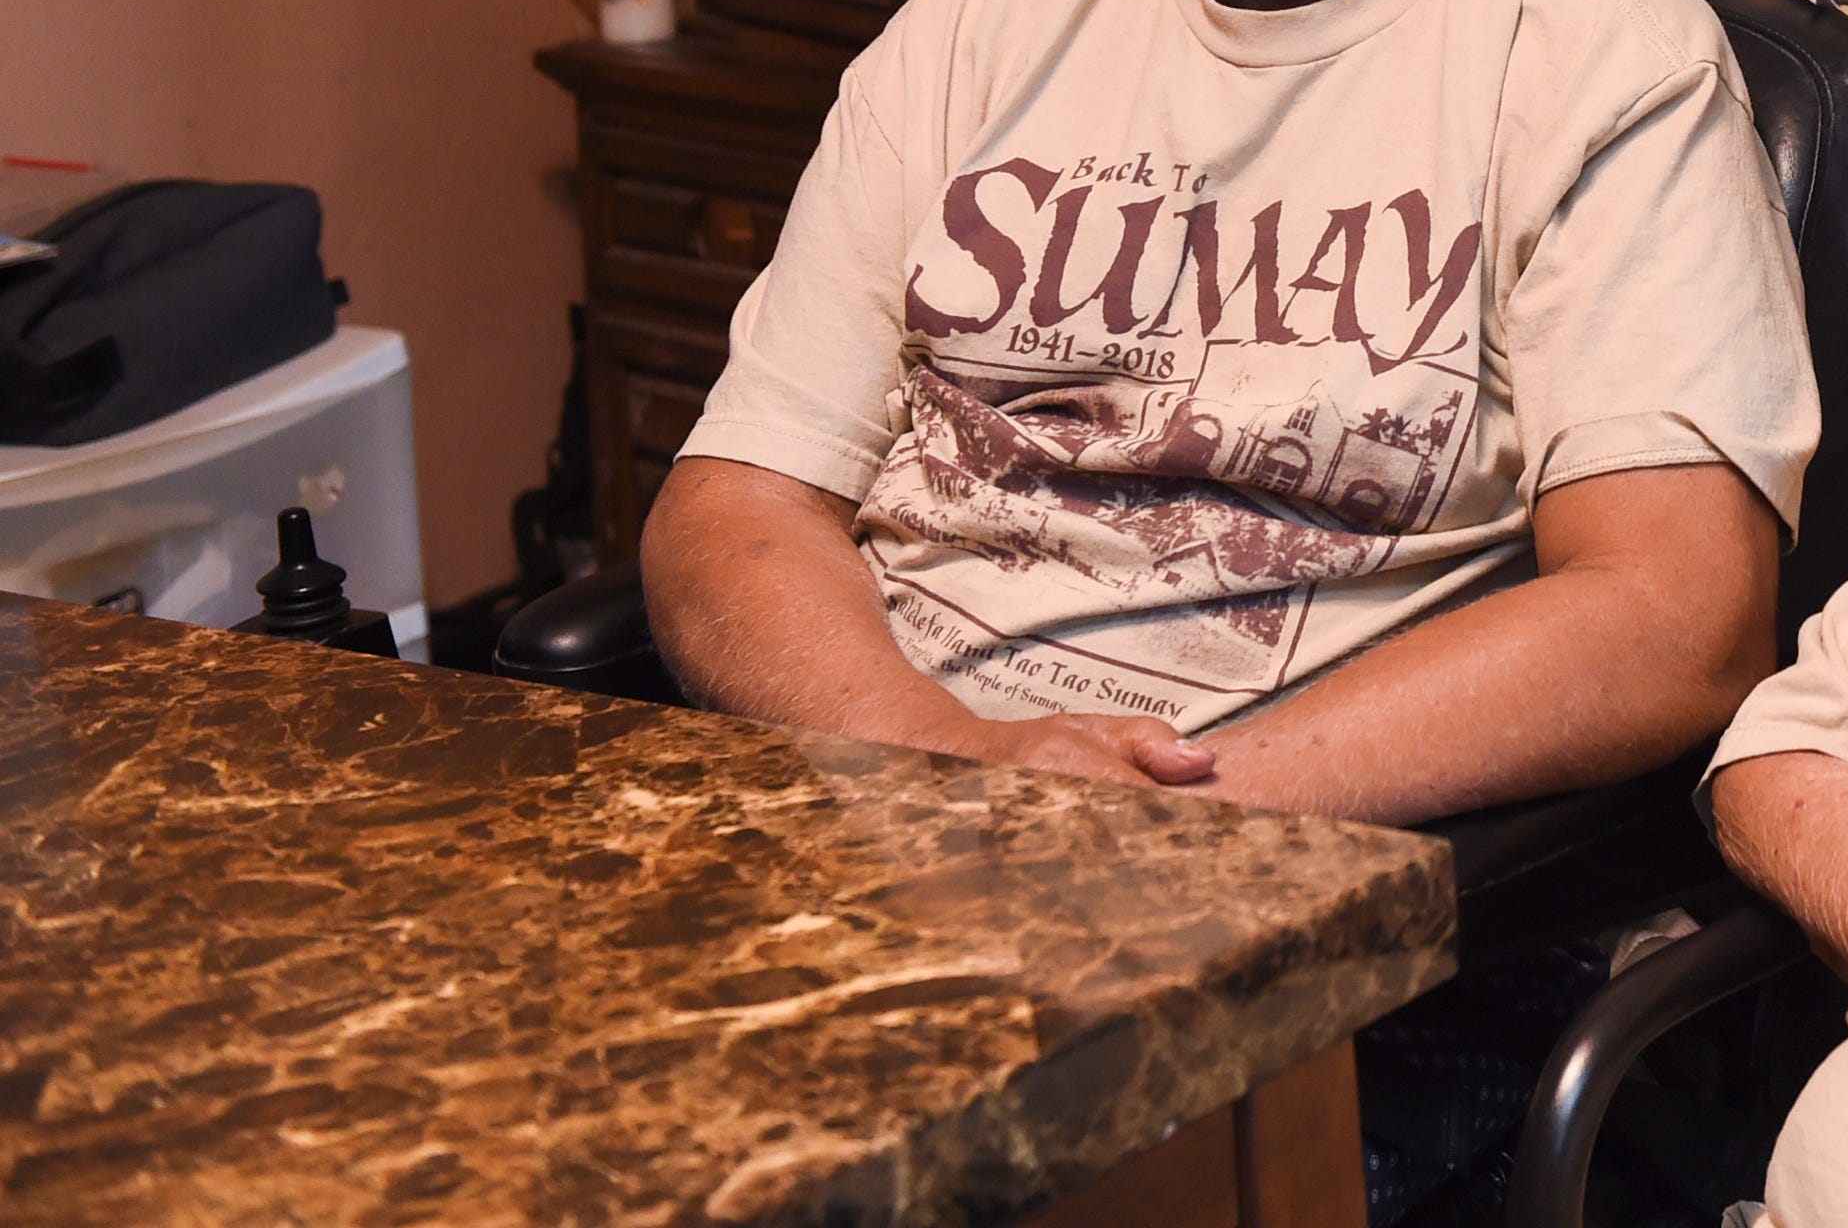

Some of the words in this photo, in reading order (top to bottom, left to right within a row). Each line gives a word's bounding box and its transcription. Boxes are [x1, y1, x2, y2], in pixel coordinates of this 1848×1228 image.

[1070, 151, 1157, 188] Back
[1172, 163, 1208, 194] To
[1007, 322, 1176, 380] 1941-2018
[966, 664, 1003, 693] People
[1004, 683, 1019, 702] of
[1003, 645, 1043, 677] Tao
[1050, 660, 1092, 694] Tao
[1096, 676, 1188, 724] Sumay
